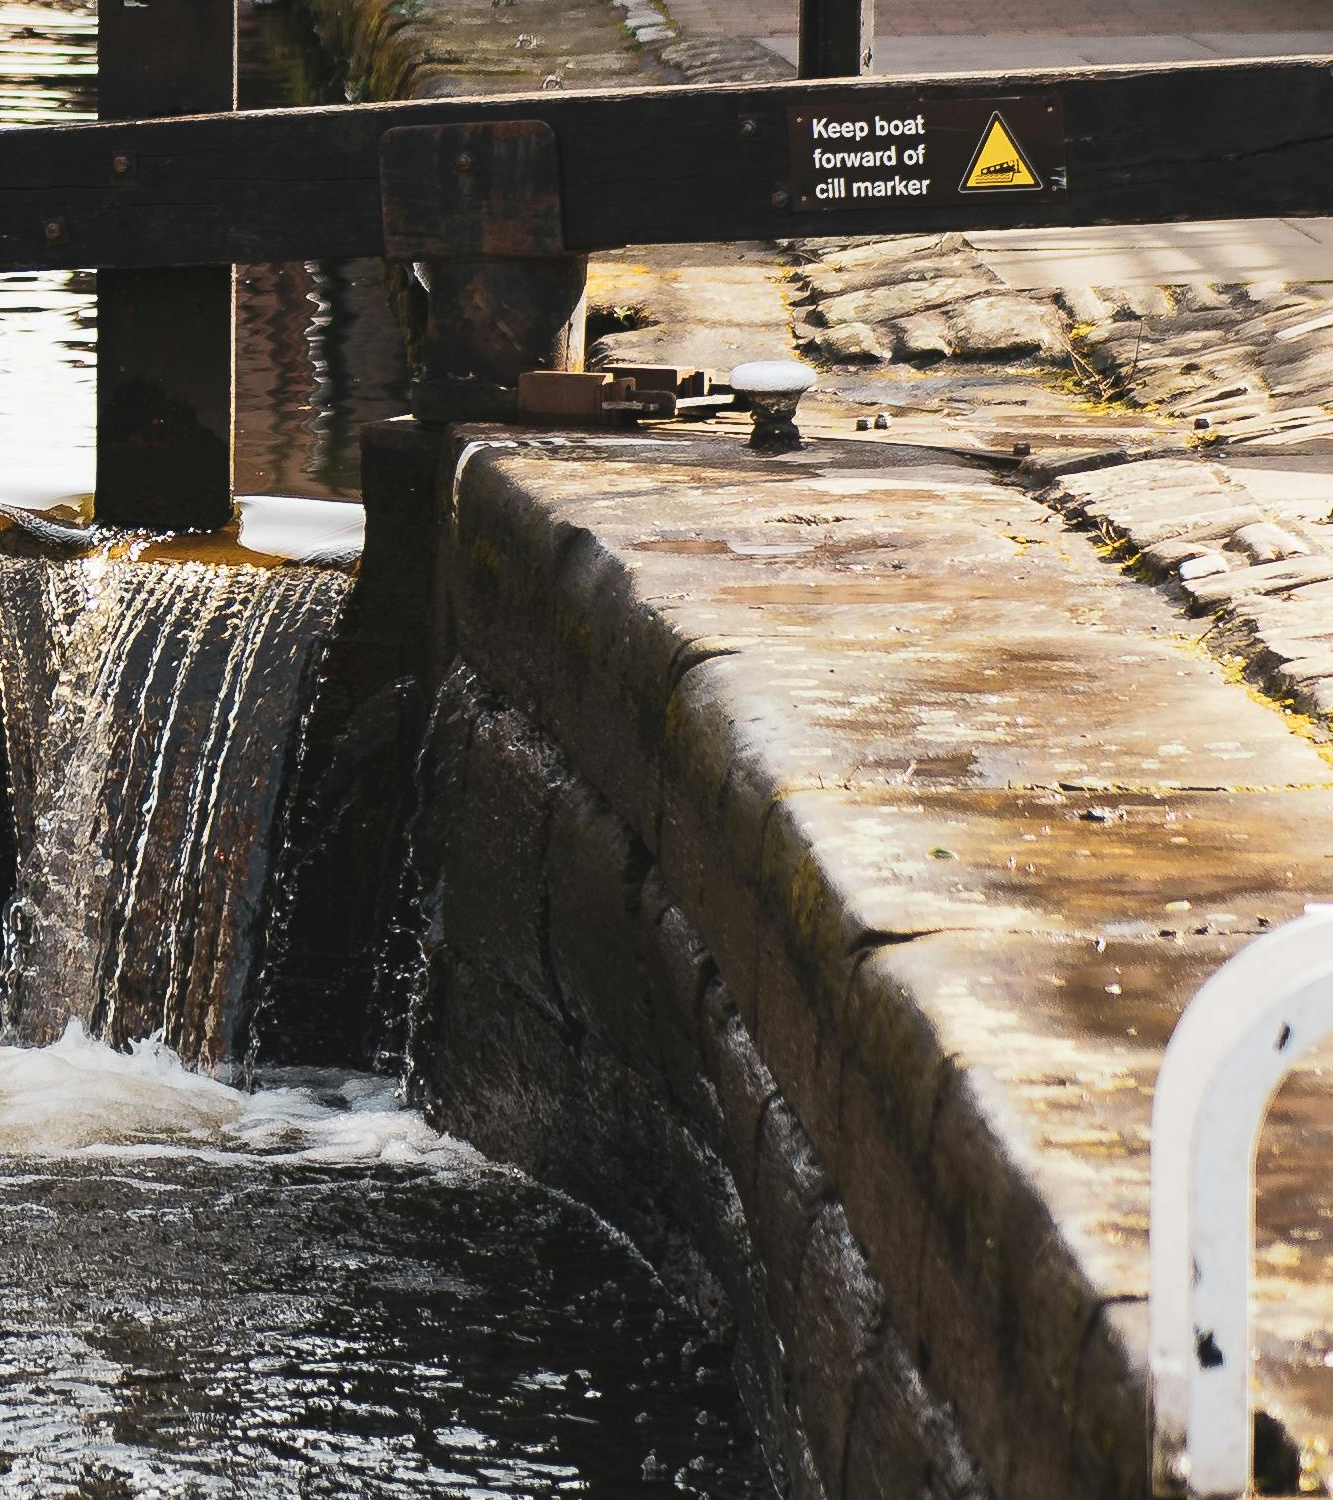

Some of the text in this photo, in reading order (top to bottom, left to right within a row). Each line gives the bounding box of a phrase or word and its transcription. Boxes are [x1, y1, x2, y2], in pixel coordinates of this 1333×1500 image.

[813, 114, 925, 142] Keep boat
[813, 144, 926, 168] forward of
[815, 175, 930, 199] cill marker
